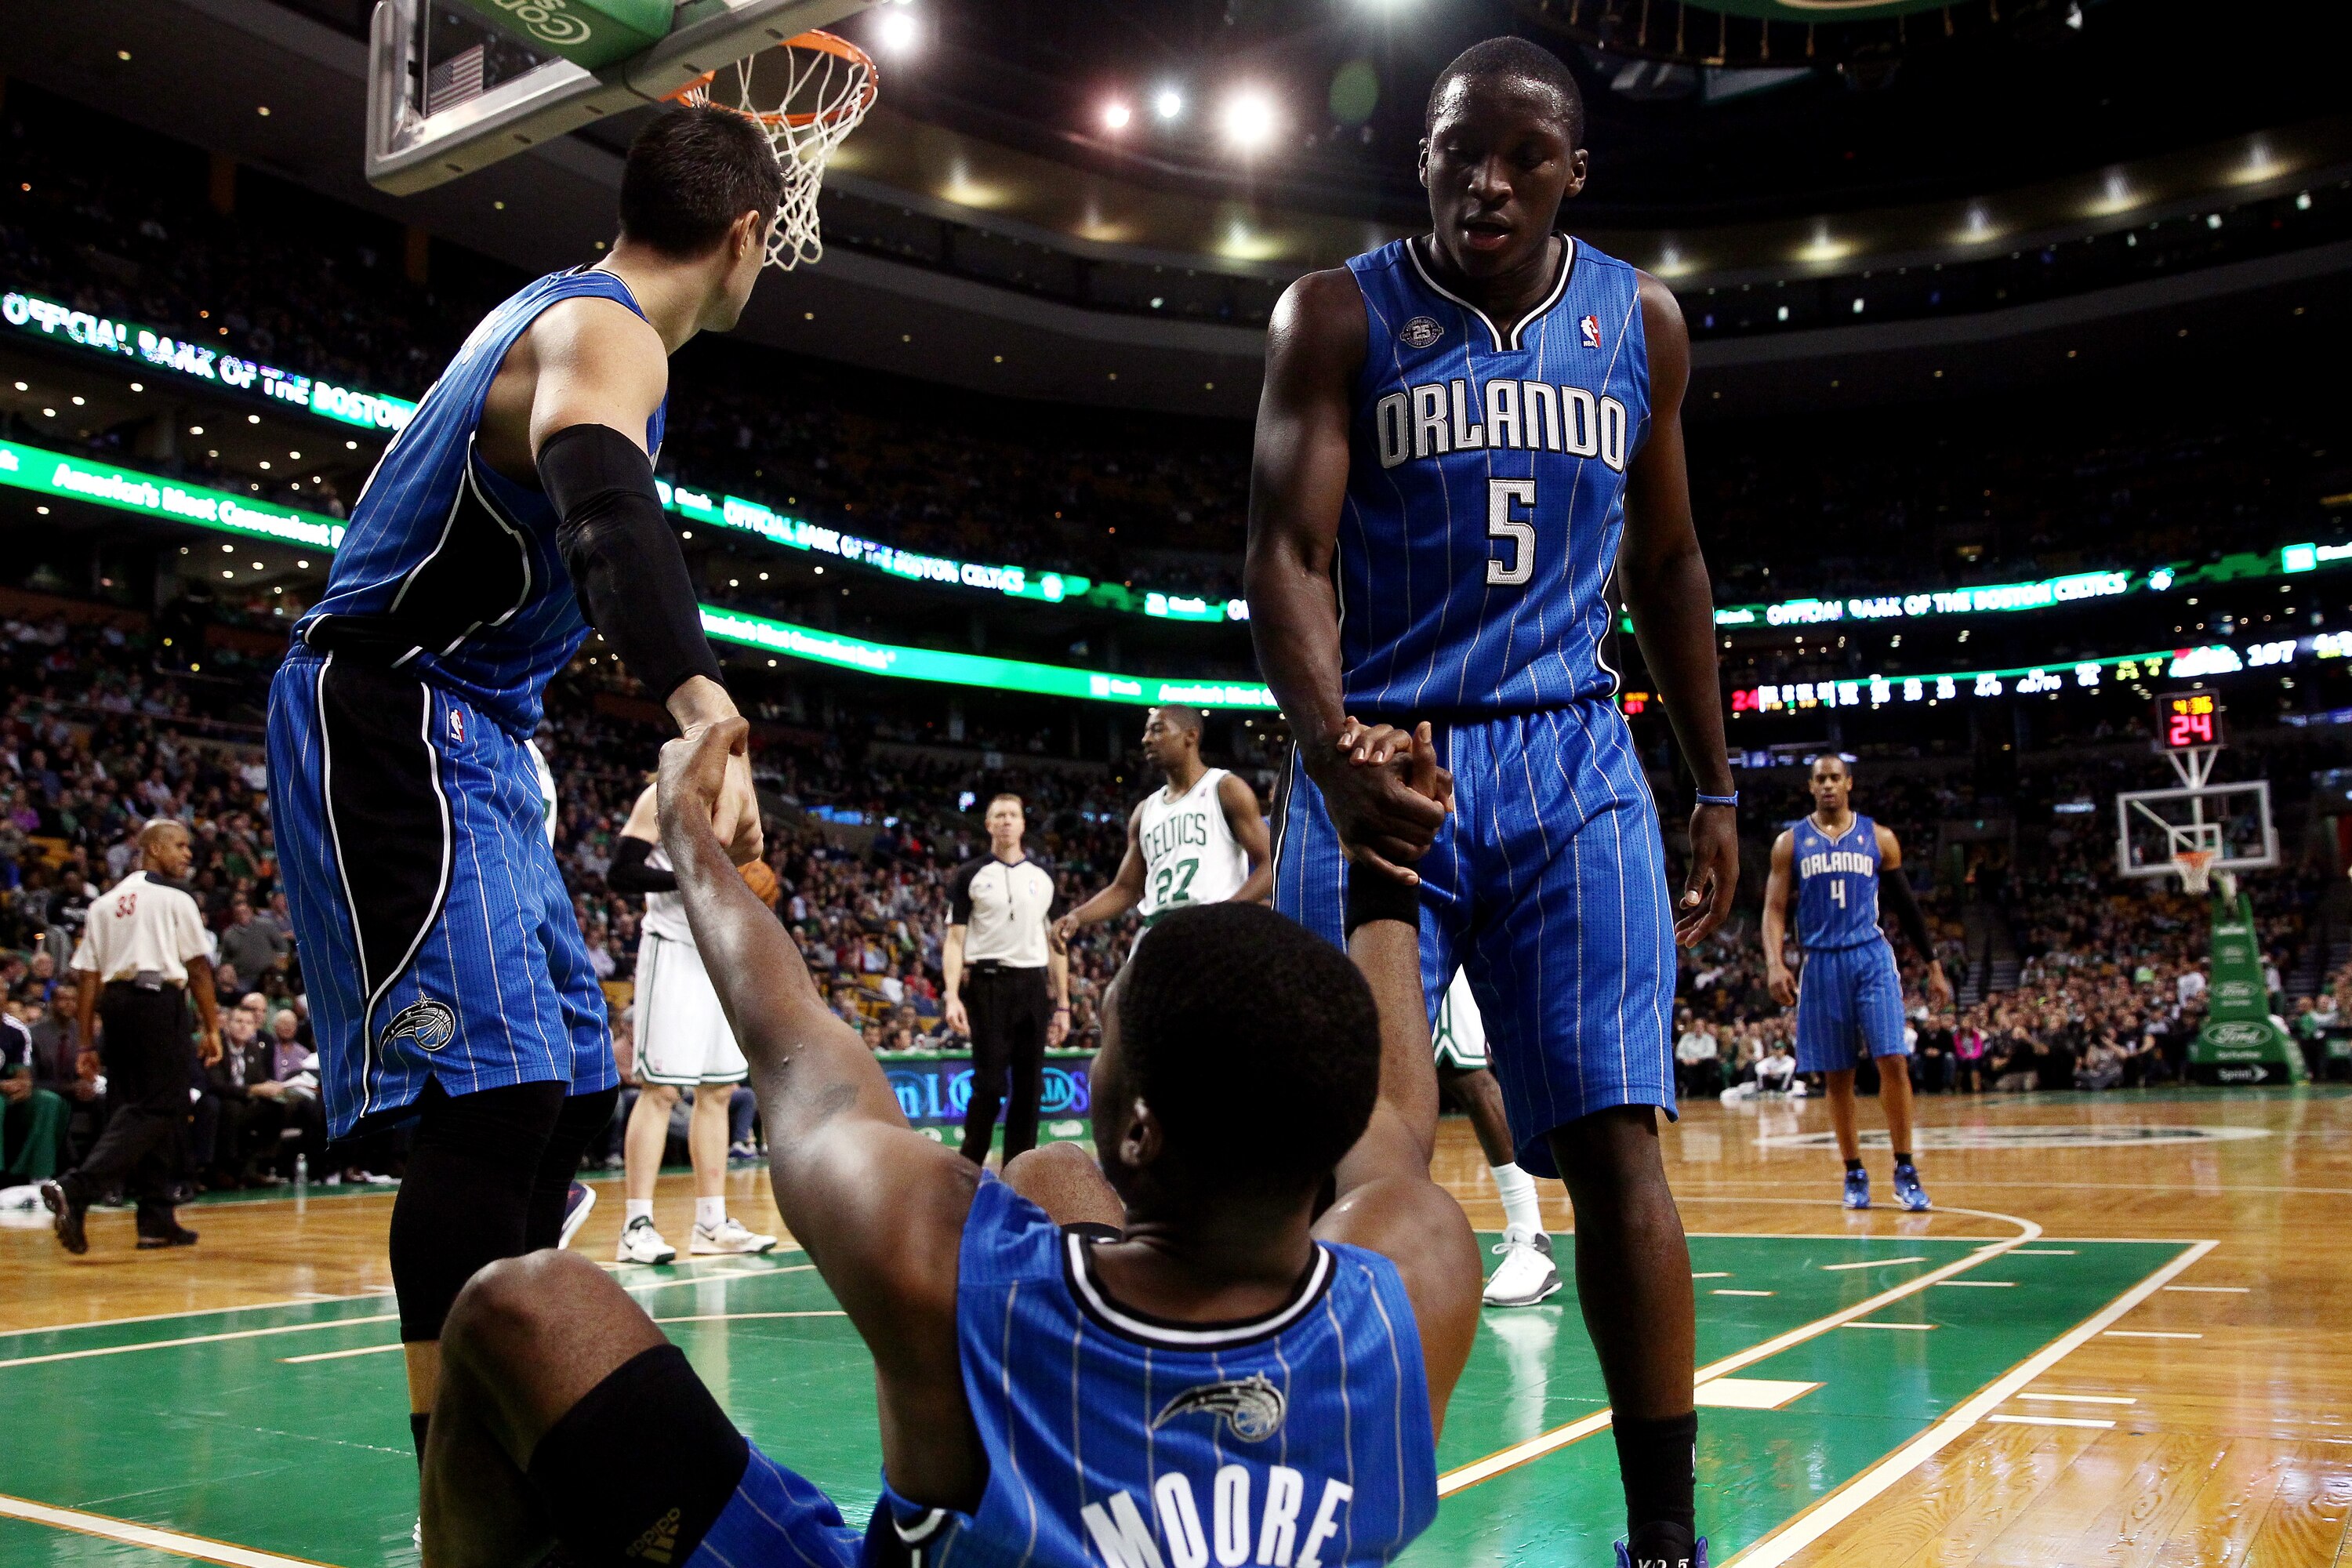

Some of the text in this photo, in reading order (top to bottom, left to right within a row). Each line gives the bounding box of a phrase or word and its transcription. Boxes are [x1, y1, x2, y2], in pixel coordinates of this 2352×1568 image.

[1376, 378, 1627, 472] ORLANDO
[1486, 477, 1537, 586] 5
[2170, 714, 2212, 745] 24
[1145, 813, 1206, 866] CELTICS
[1156, 858, 1199, 906] 27
[1799, 851, 1874, 880] ORLANDO
[1830, 879, 1846, 909] 4
[1080, 1463, 1354, 1568] MOORE
